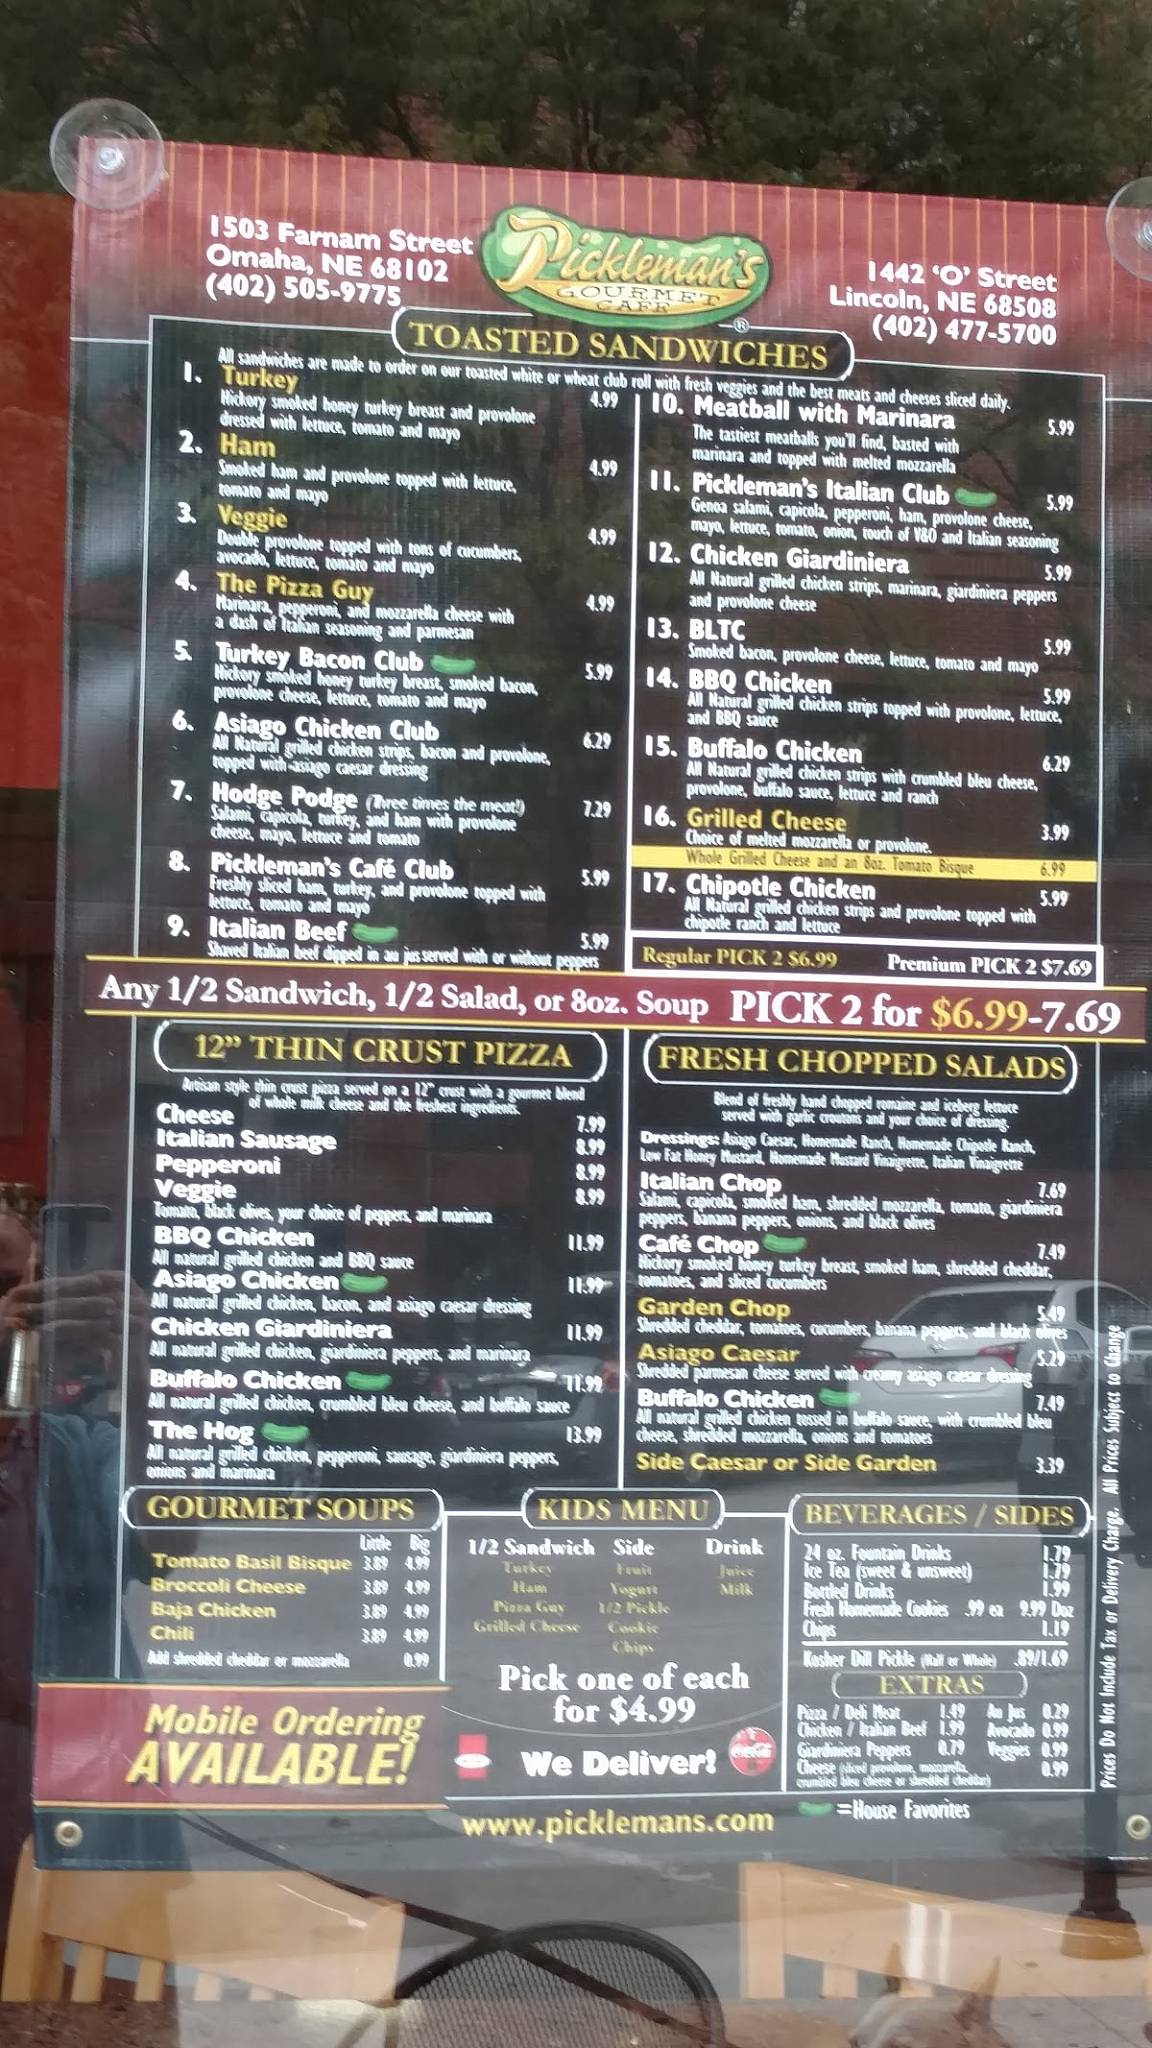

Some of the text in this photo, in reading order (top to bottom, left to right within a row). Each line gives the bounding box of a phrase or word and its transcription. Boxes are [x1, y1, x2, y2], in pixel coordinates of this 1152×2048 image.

[210, 214, 474, 255] 1503 Farnam Street
[206, 243, 449, 283] Omaha, NE 68102
[495, 213, 765, 292] Pickleman's
[205, 272, 402, 307] (402) 505-9775
[867, 259, 926, 286] 1442
[978, 265, 1058, 293] Street
[556, 285, 721, 307] GOURMET
[829, 284, 1057, 320] Lincoln, NE 68508
[872, 312, 1058, 347] (402) 477-5700
[408, 319, 829, 371] TOASTED SANDWICHES
[222, 364, 299, 392] Turkey
[589, 390, 618, 408] 4.99
[694, 396, 956, 431] Meatball with Marinara
[1047, 418, 1075, 437] 5.99
[219, 432, 276, 459] Ham
[692, 424, 712, 442] The
[719, 426, 760, 445] tastiest
[765, 428, 820, 448] meatballs
[860, 433, 888, 453] find,
[892, 435, 930, 455] basted
[934, 437, 960, 455] with
[827, 478, 895, 503] Italian
[902, 482, 951, 507] Club
[217, 504, 289, 531] Veggie
[690, 543, 911, 576] Chicken Giardiniera
[1044, 564, 1073, 583] 5.99
[216, 571, 374, 604] The Pizza Guy
[689, 617, 746, 642] BLTC
[216, 641, 424, 673] Turkey Bacon Club
[584, 662, 614, 681] 5.99
[688, 668, 833, 696] BBQ Chicken
[214, 711, 440, 743] Asiago Chicken Club
[687, 736, 864, 765] Buffalo Chicken
[1042, 755, 1071, 774] 6.29
[212, 781, 359, 814] Hodge Podge
[687, 806, 848, 833] Grilled Cheese
[349, 856, 397, 881] Café
[404, 859, 454, 882] Club
[1040, 860, 1067, 878] 6.99
[686, 871, 877, 902] Chipotle Chicken
[209, 915, 349, 942] Italian Beef
[642, 944, 838, 970] Regular PICK 2 $6.99
[98, 975, 1122, 1036] Any 1/2 Sandwich, 1/2 Salad, or 8oz. Soup PICK 2 for $6.99-7.69
[250, 1034, 345, 1063] THIN
[352, 1038, 466, 1066] CRUST
[474, 1041, 574, 1070] PIZZA
[658, 1046, 1068, 1082] FRESH CHOPPED SALADS
[156, 1129, 338, 1156] Italian Sausage
[155, 1154, 282, 1180] Pepperoni
[639, 1170, 783, 1198] Italian Chop
[1037, 1181, 1067, 1200] 7.69
[154, 1226, 315, 1251] BBQ Chicken
[639, 1233, 760, 1260] Café Chop
[637, 1297, 792, 1324] Garden Chop
[148, 1421, 256, 1447] The Hog
[635, 1452, 938, 1474] Side Caesar or Side Garden
[147, 1495, 416, 1522] GOURMET SOUPS
[536, 1497, 710, 1522] KIDS MENU
[804, 1503, 1076, 1529] BEVERAGES / SIDES
[151, 1552, 353, 1577] Tomato Basil Bisque
[1099, 1325, 1127, 1789] Prices Do Not Include Tax or Delivery Charge. All Prices Subject to Change
[498, 1661, 751, 1692] Pick one of each
[879, 1675, 986, 1697] EXTRAS
[552, 1694, 697, 1726] for $4.99
[144, 1703, 426, 1746] Mobile Ordering
[126, 1739, 417, 1787] AVAILABLE!
[520, 1751, 573, 1777] We
[582, 1748, 718, 1778] Deliver!
[903, 1799, 972, 1821] Favorites
[462, 1808, 775, 1844] www.picklemans.com
